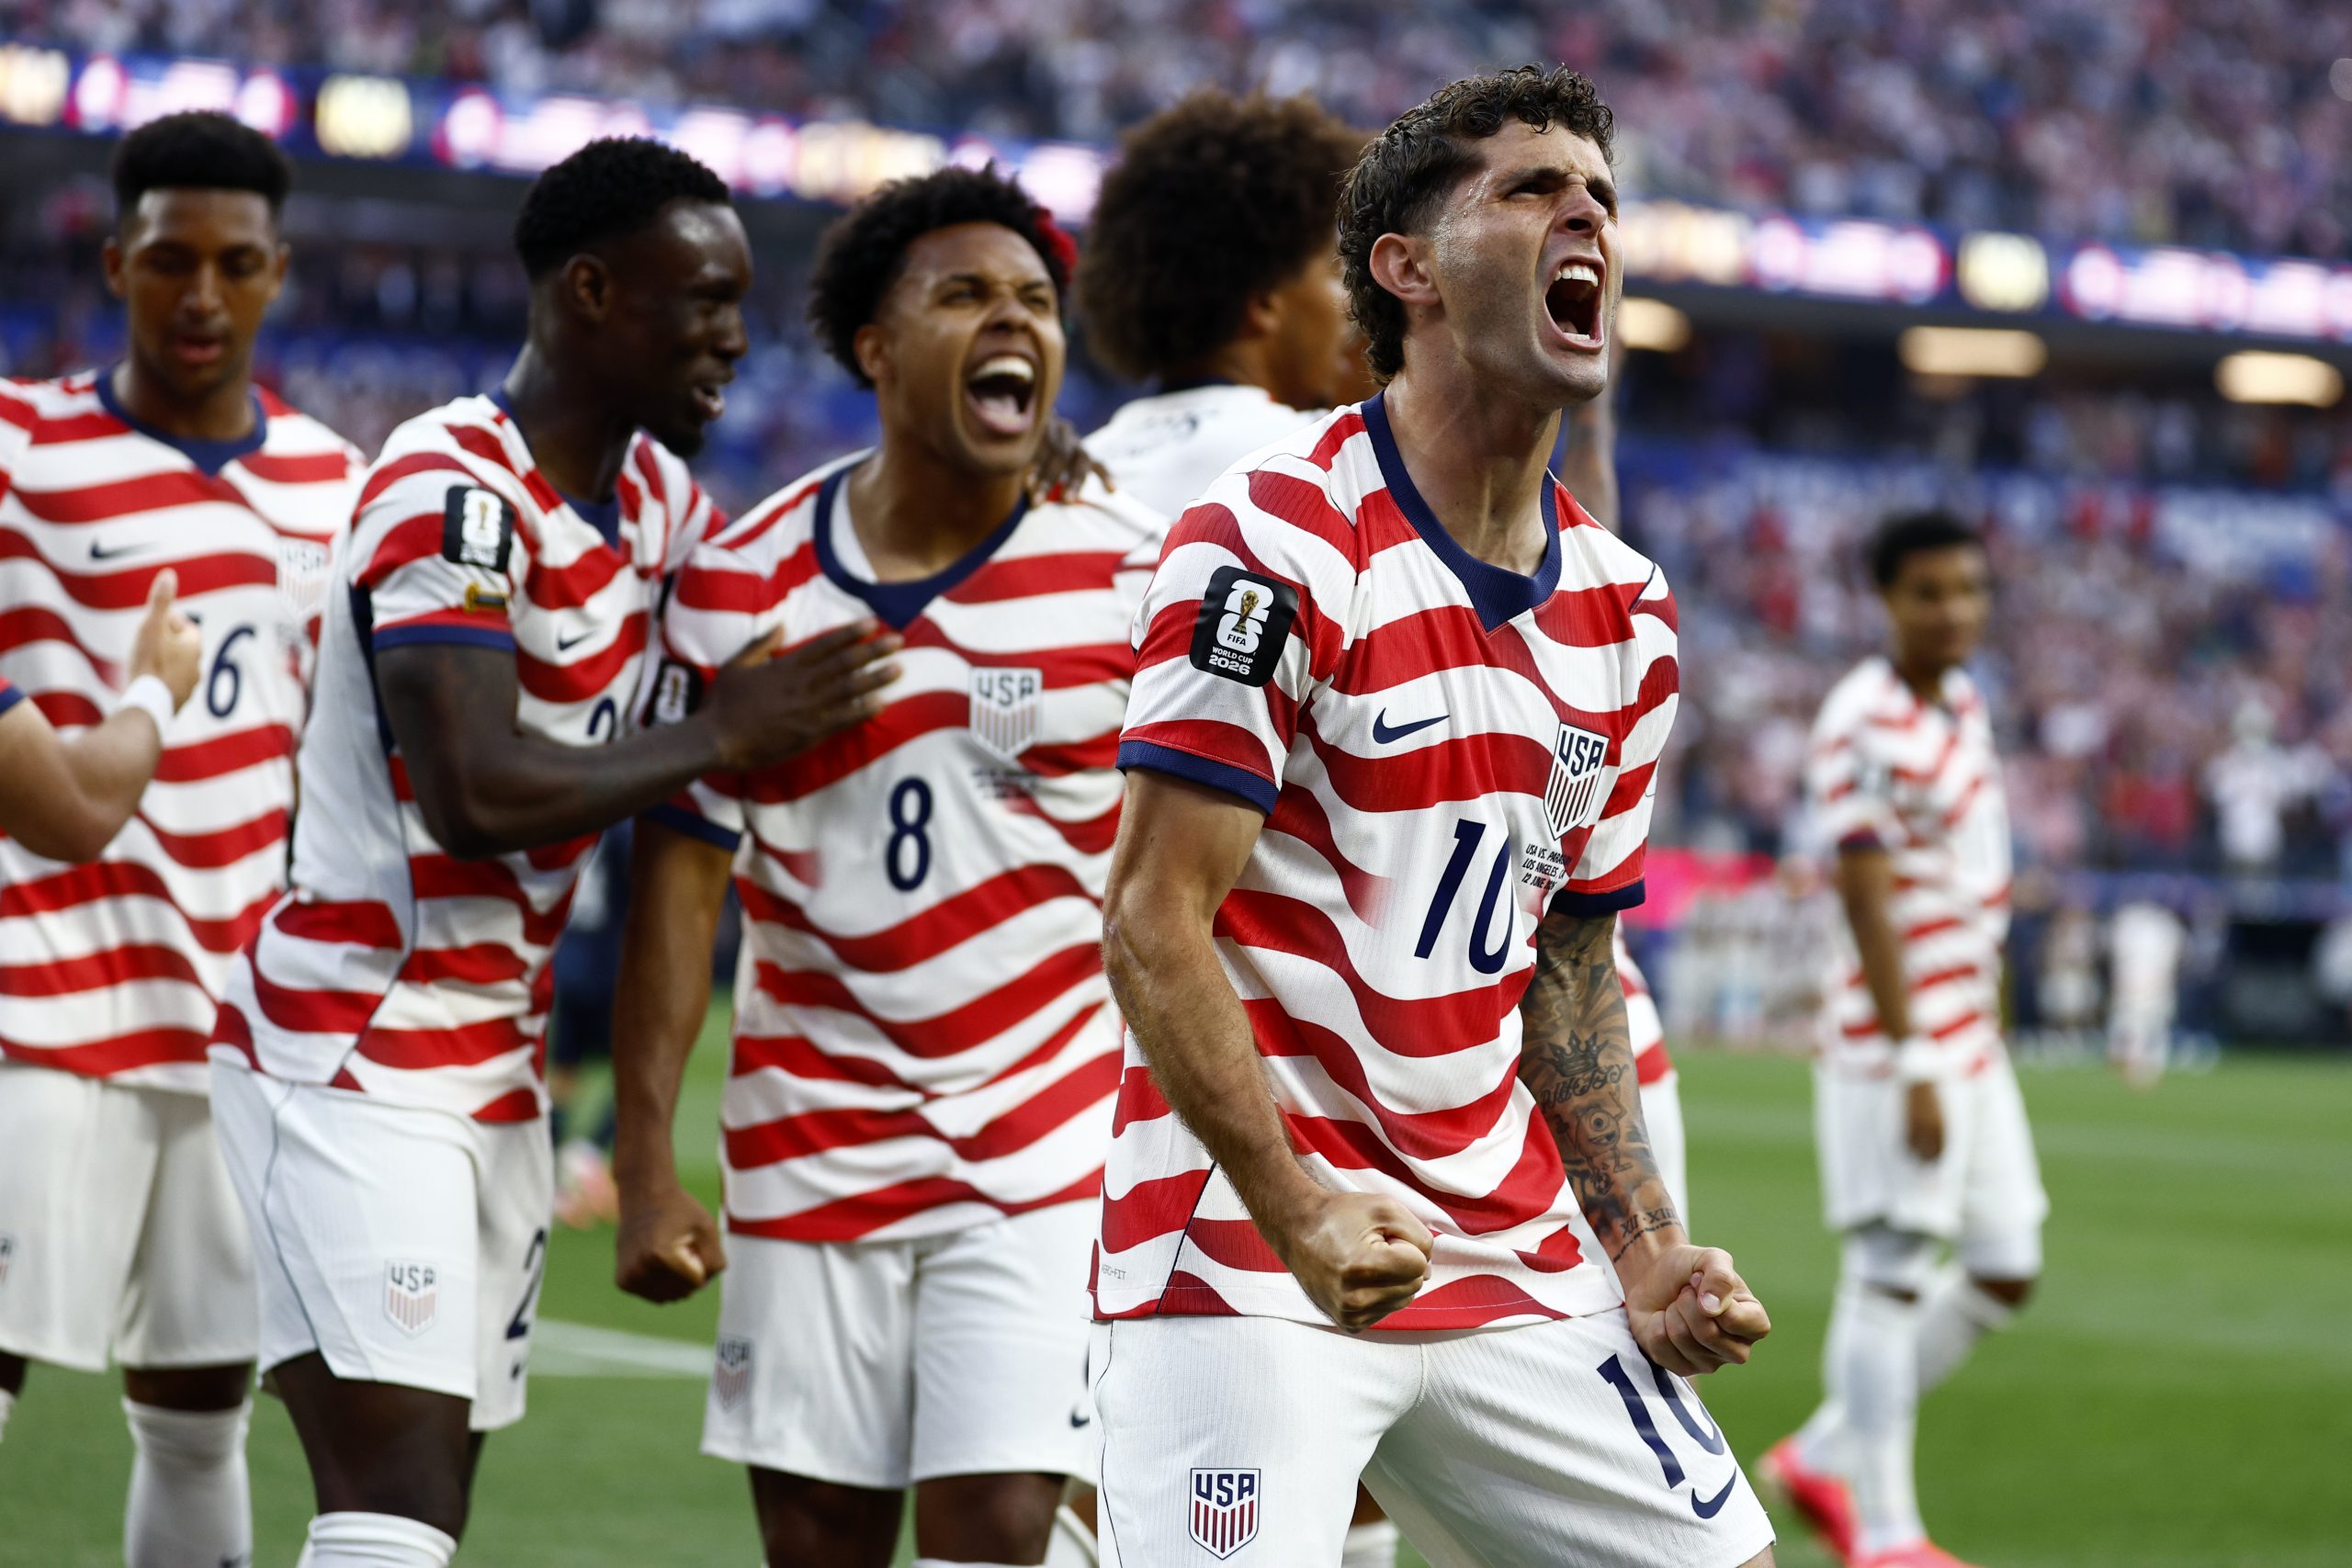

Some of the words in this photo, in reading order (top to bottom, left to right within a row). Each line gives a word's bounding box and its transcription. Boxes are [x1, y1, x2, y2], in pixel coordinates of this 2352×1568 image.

[1227, 634, 1247, 647] FIFA
[187, 611, 255, 719] 6
[1208, 654, 1250, 676] 2026
[1212, 646, 1238, 660] WORLD
[1238, 654, 1253, 665] CUP
[977, 675, 1035, 707] USA
[1558, 730, 1604, 777] USA
[886, 775, 934, 893] 8
[1526, 843, 1538, 855] USA
[1521, 873, 1532, 883] 12
[1522, 858, 1536, 870] LOS
[1414, 818, 1515, 975] 10
[390, 1263, 435, 1292] USA
[1195, 1473, 1255, 1507] USA
